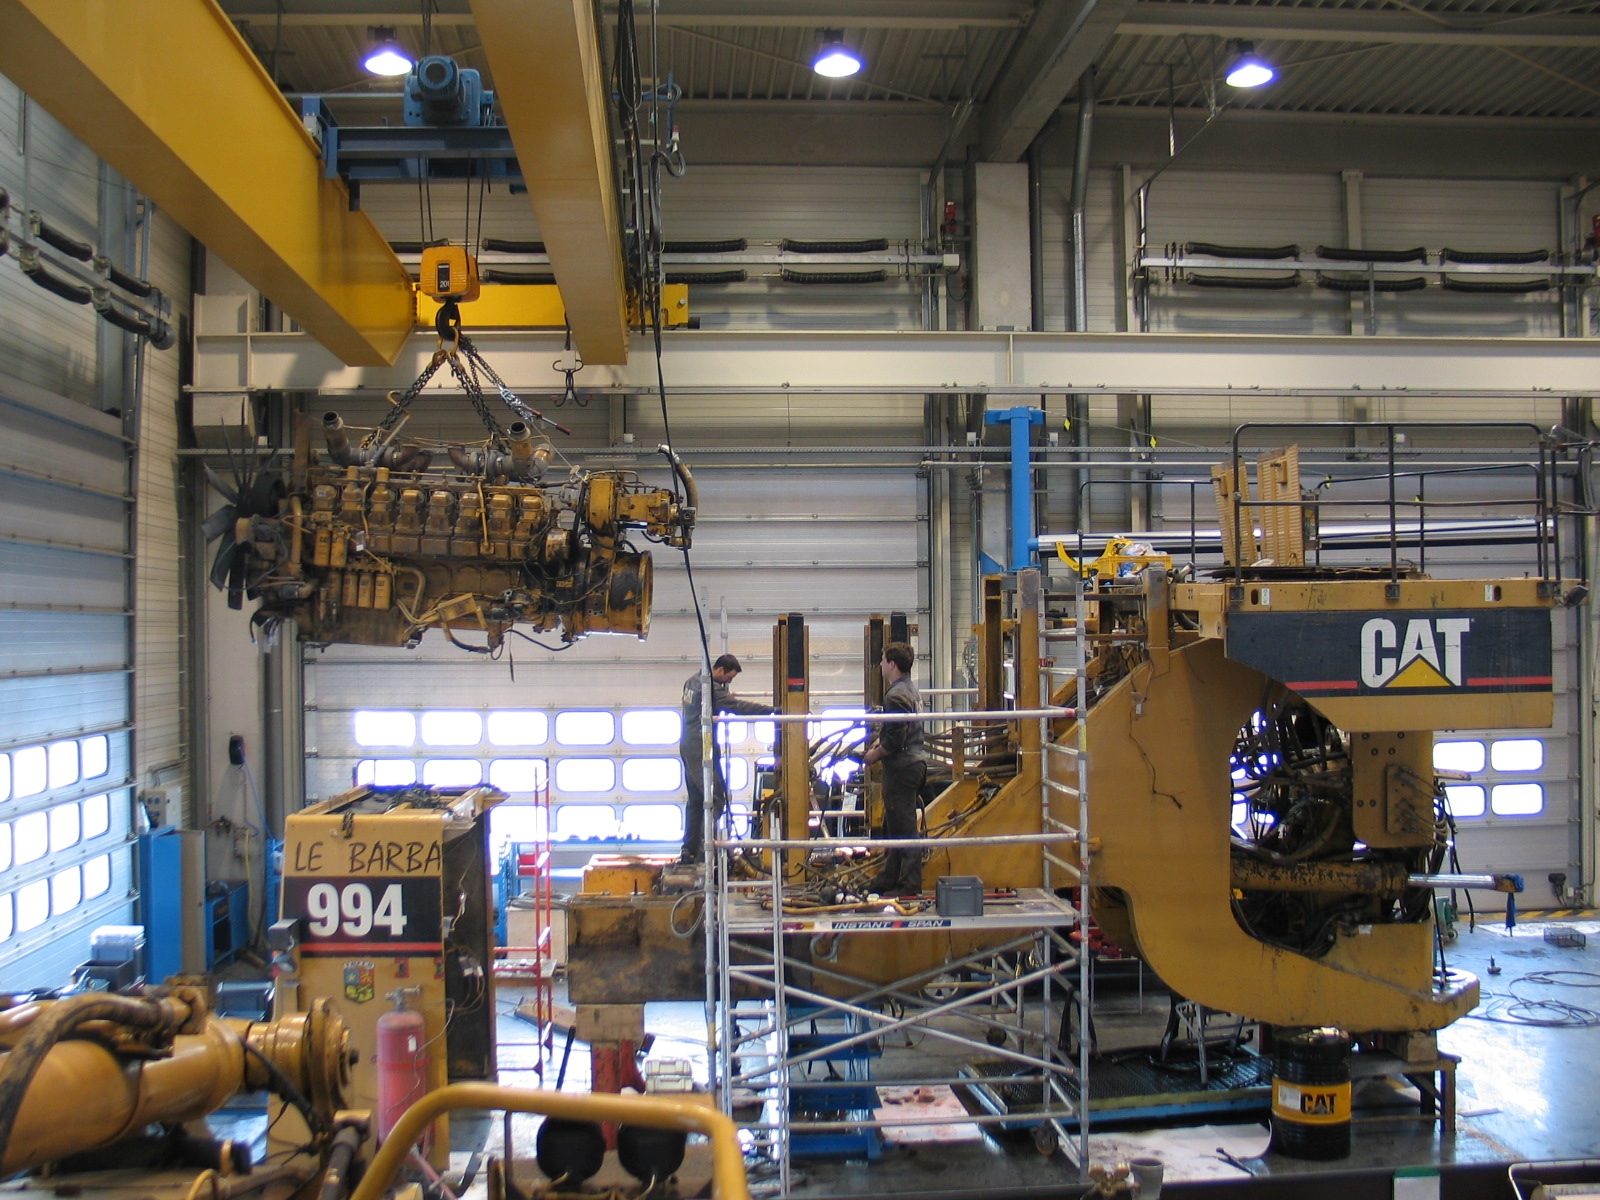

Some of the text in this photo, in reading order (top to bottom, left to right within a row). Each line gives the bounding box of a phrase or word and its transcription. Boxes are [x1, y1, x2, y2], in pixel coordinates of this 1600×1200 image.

[1361, 617, 1470, 688] CAT
[295, 841, 324, 872] LE
[308, 883, 407, 936] 994
[907, 919, 943, 928] SPAN
[1301, 1094, 1336, 1114] CAT
